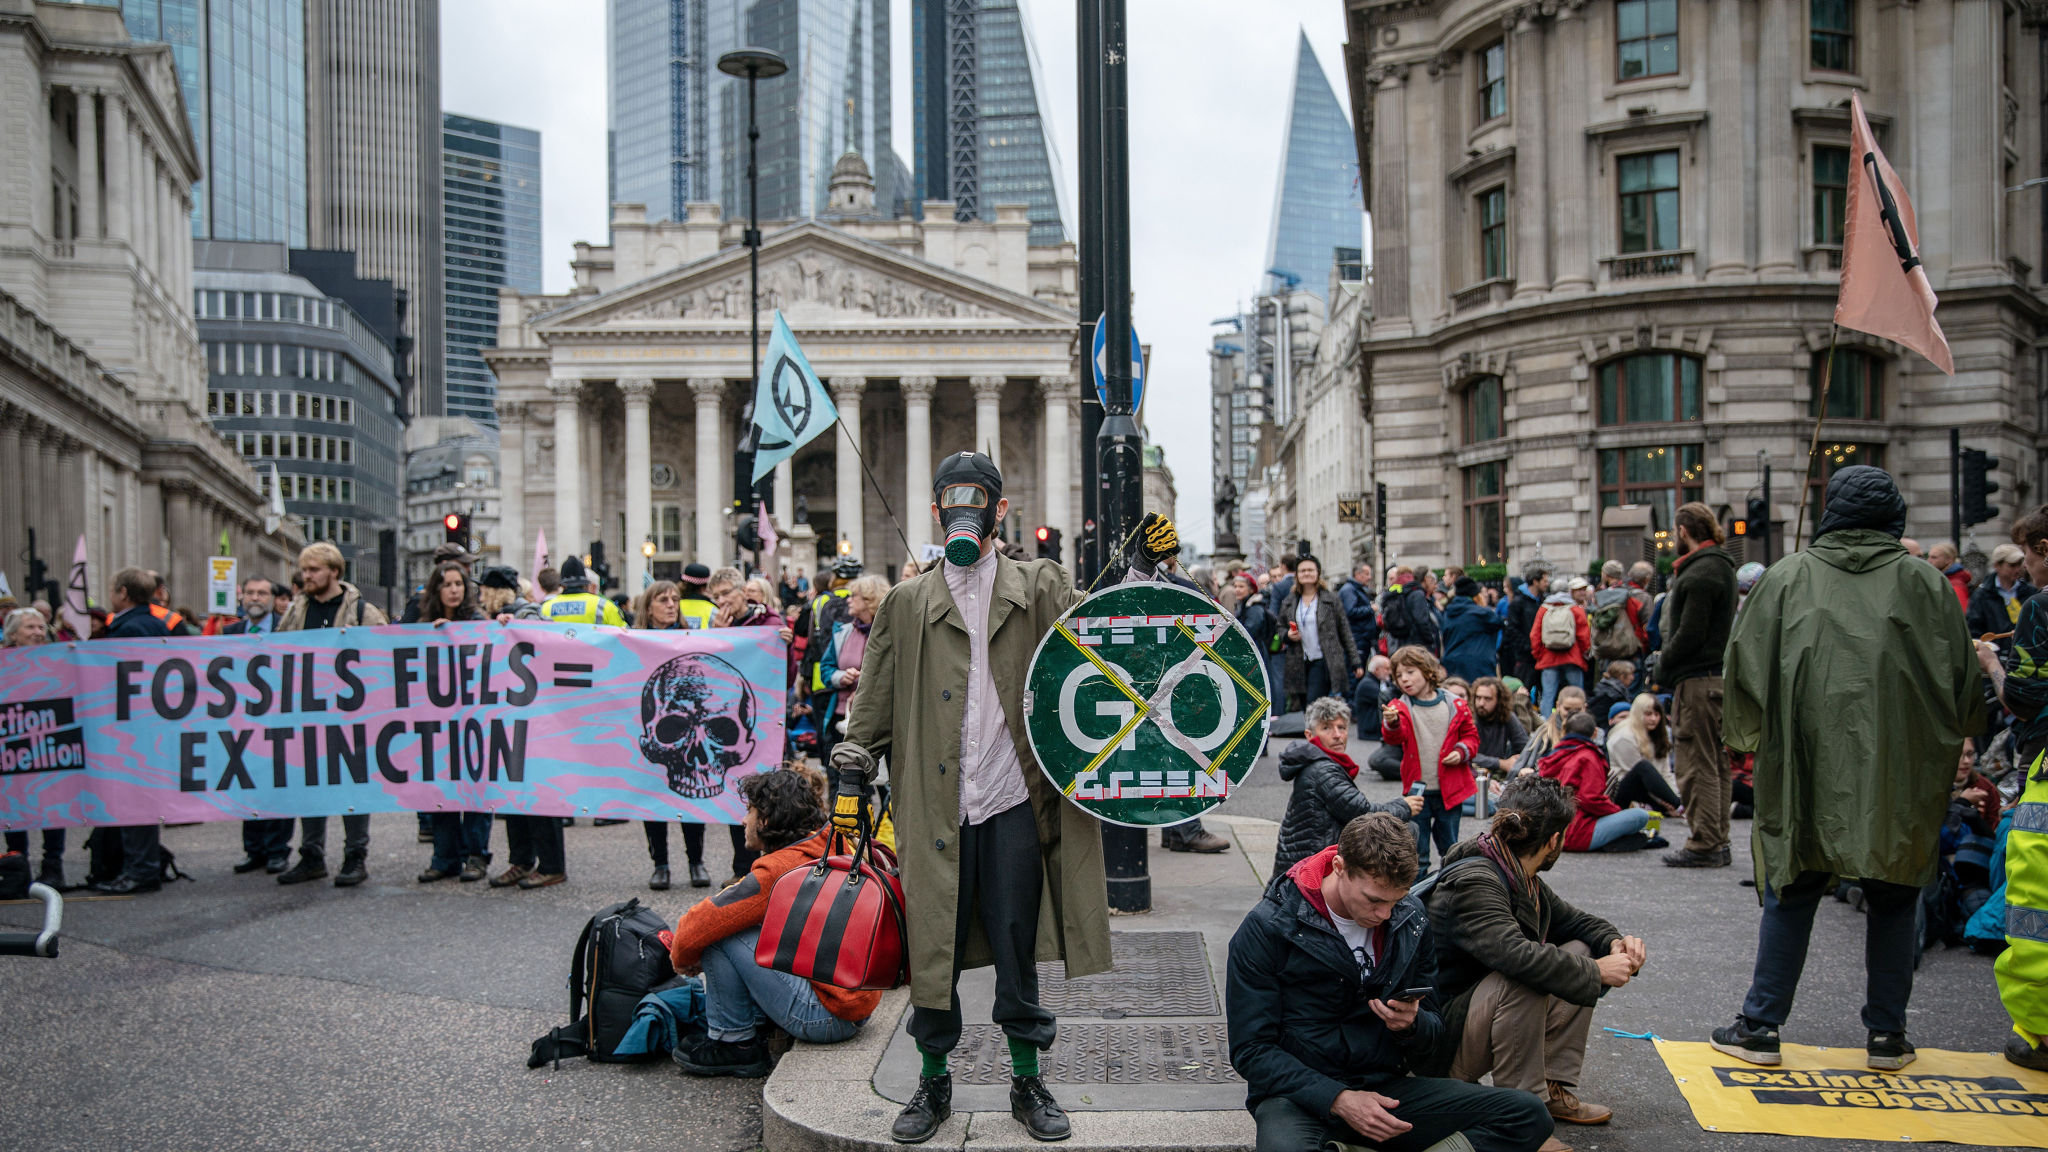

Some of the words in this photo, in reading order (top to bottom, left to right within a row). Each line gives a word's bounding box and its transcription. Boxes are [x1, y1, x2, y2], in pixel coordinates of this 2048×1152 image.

[552, 603, 585, 615] POLICE
[116, 648, 365, 721] FOSSILS
[393, 641, 538, 708] FUELS
[1058, 659, 1238, 752] GO
[0, 732, 82, 771] bellion
[180, 717, 528, 792] EXTINCTION
[1075, 769, 1229, 801] GREEN
[1728, 1070, 1985, 1092] extinction
